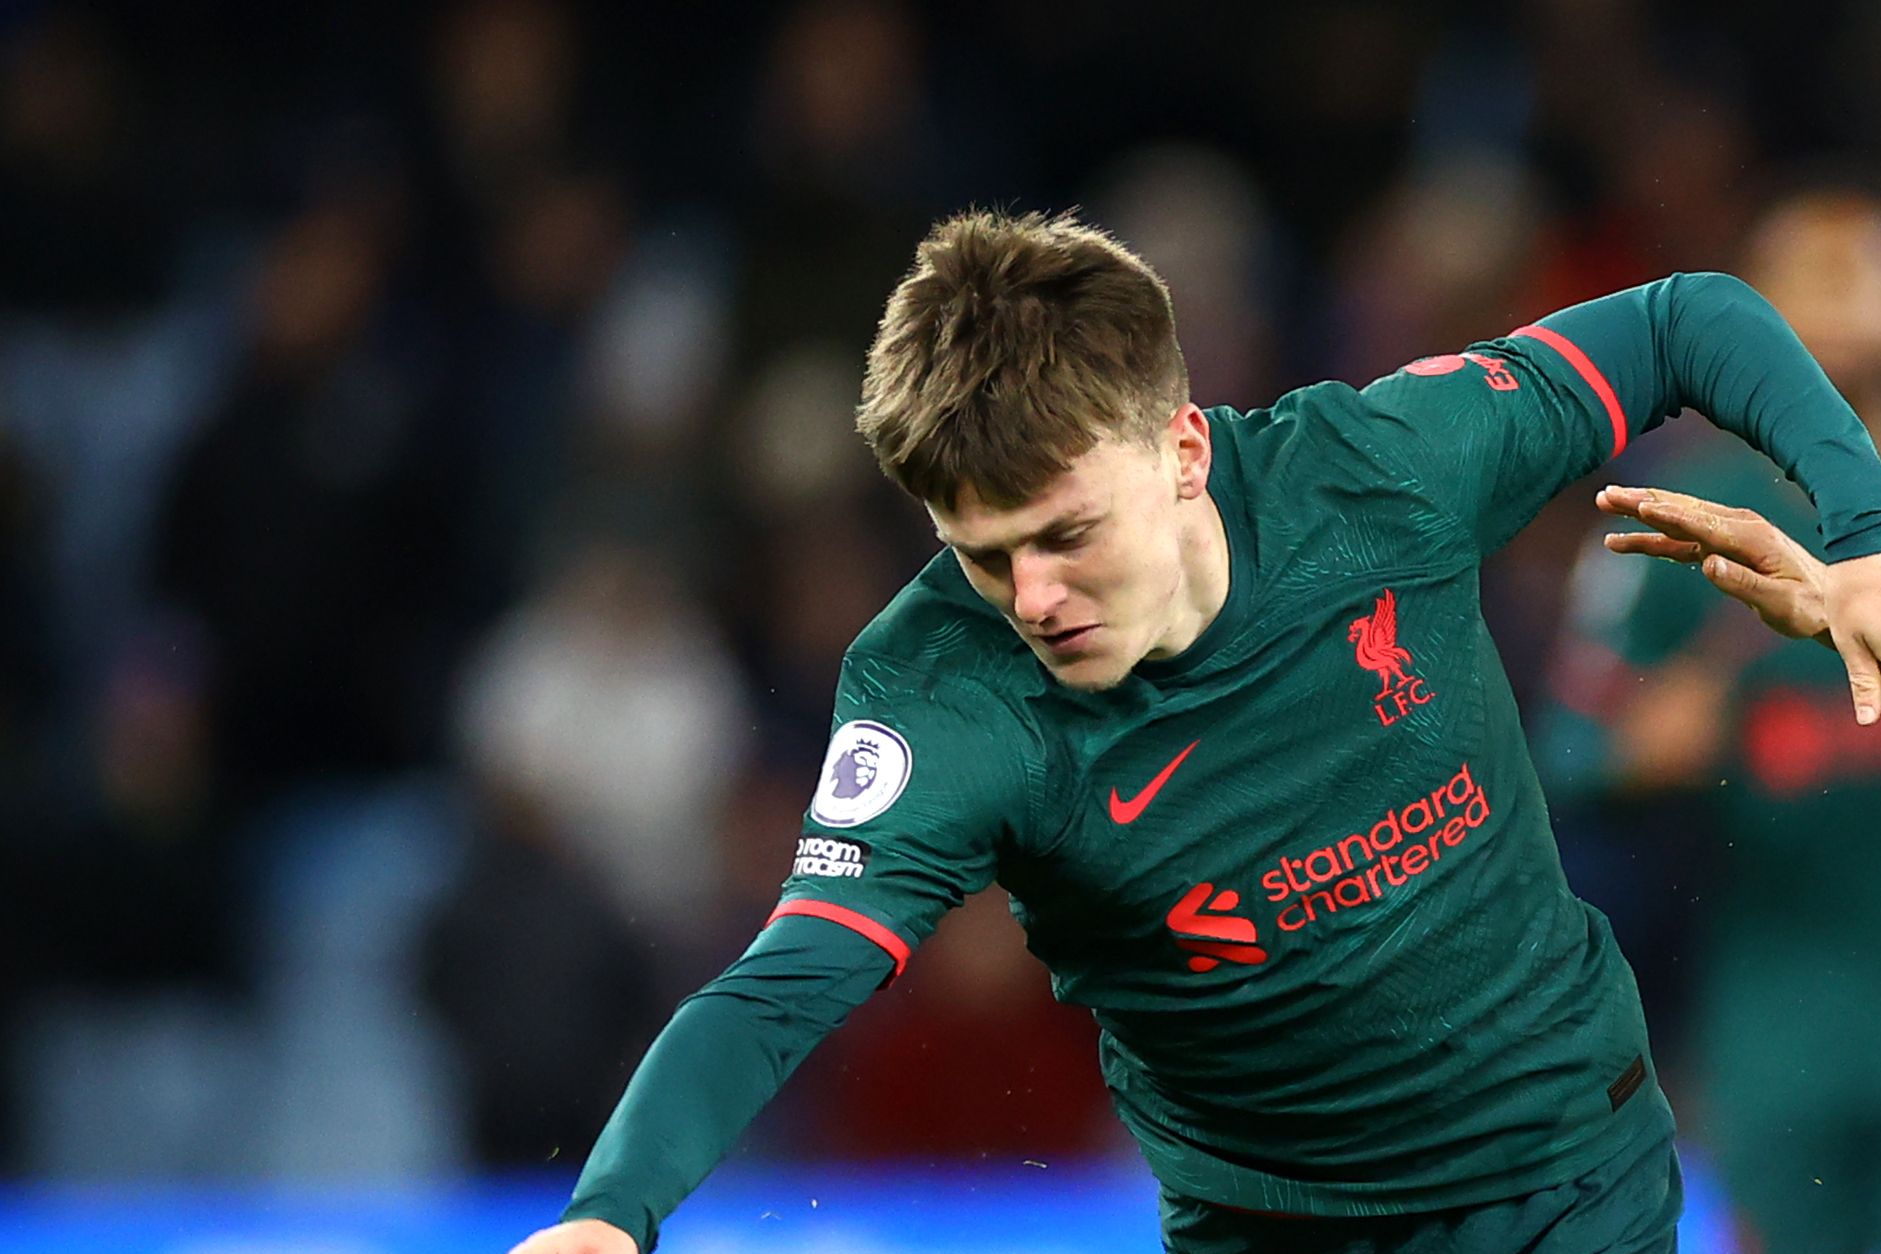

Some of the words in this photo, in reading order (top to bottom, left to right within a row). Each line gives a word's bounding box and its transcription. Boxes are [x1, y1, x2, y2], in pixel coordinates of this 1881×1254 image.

[797, 856, 864, 878] racism
[803, 838, 861, 863] room
[1262, 762, 1474, 902] standard
[1276, 785, 1490, 931] chartered
